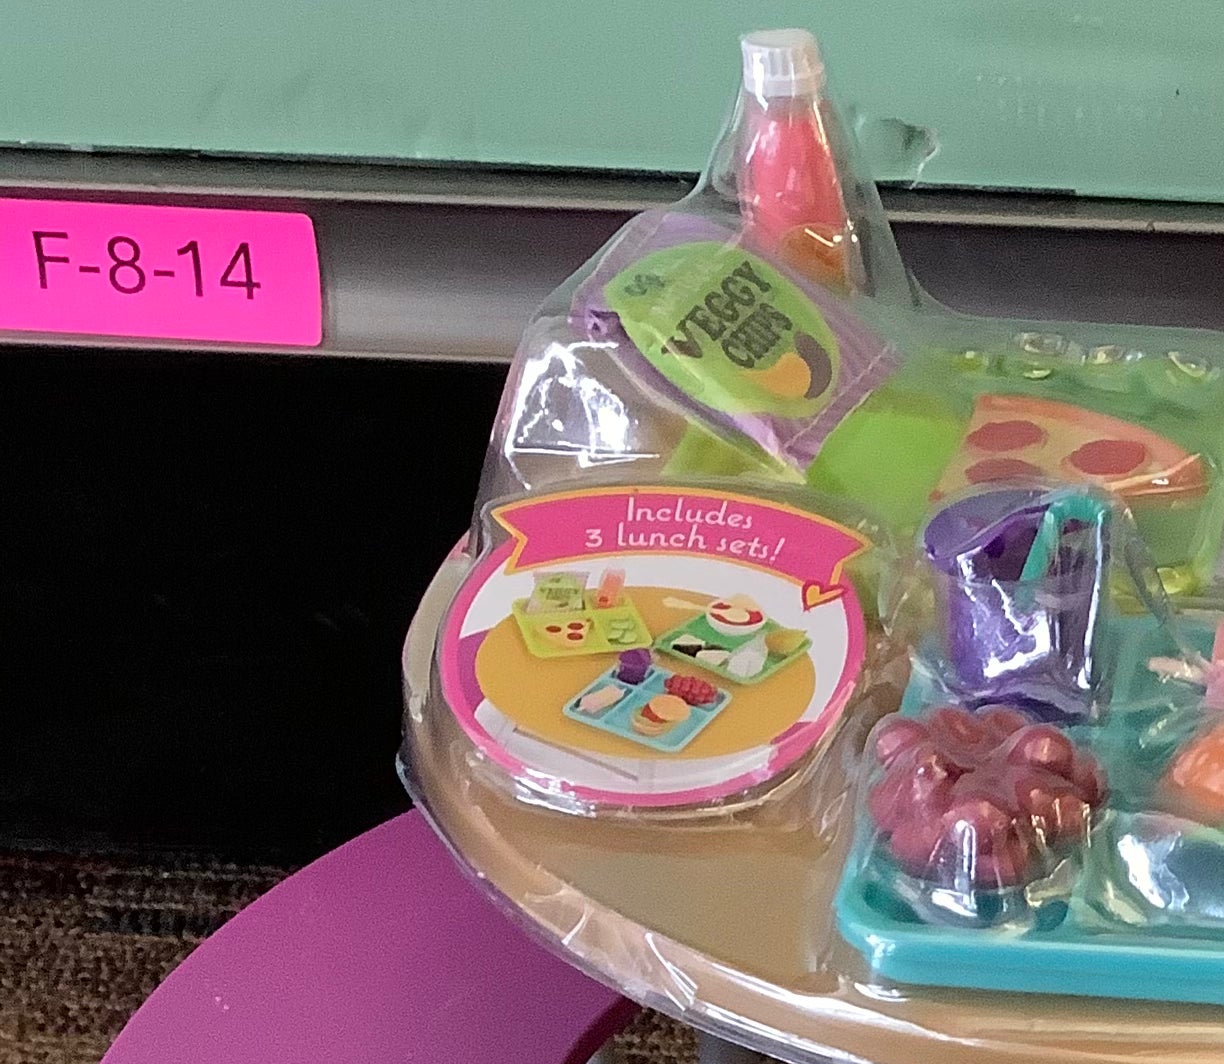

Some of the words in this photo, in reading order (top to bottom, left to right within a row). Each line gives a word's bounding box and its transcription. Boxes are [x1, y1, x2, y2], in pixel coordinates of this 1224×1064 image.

[32, 230, 262, 300] F-8-14
[660, 260, 772, 359] VEGGY
[720, 302, 794, 369] CHIPS
[584, 528, 603, 549] 3
[617, 522, 707, 550] lunch
[716, 537, 786, 562] sets!
[626, 496, 753, 530] Includes
